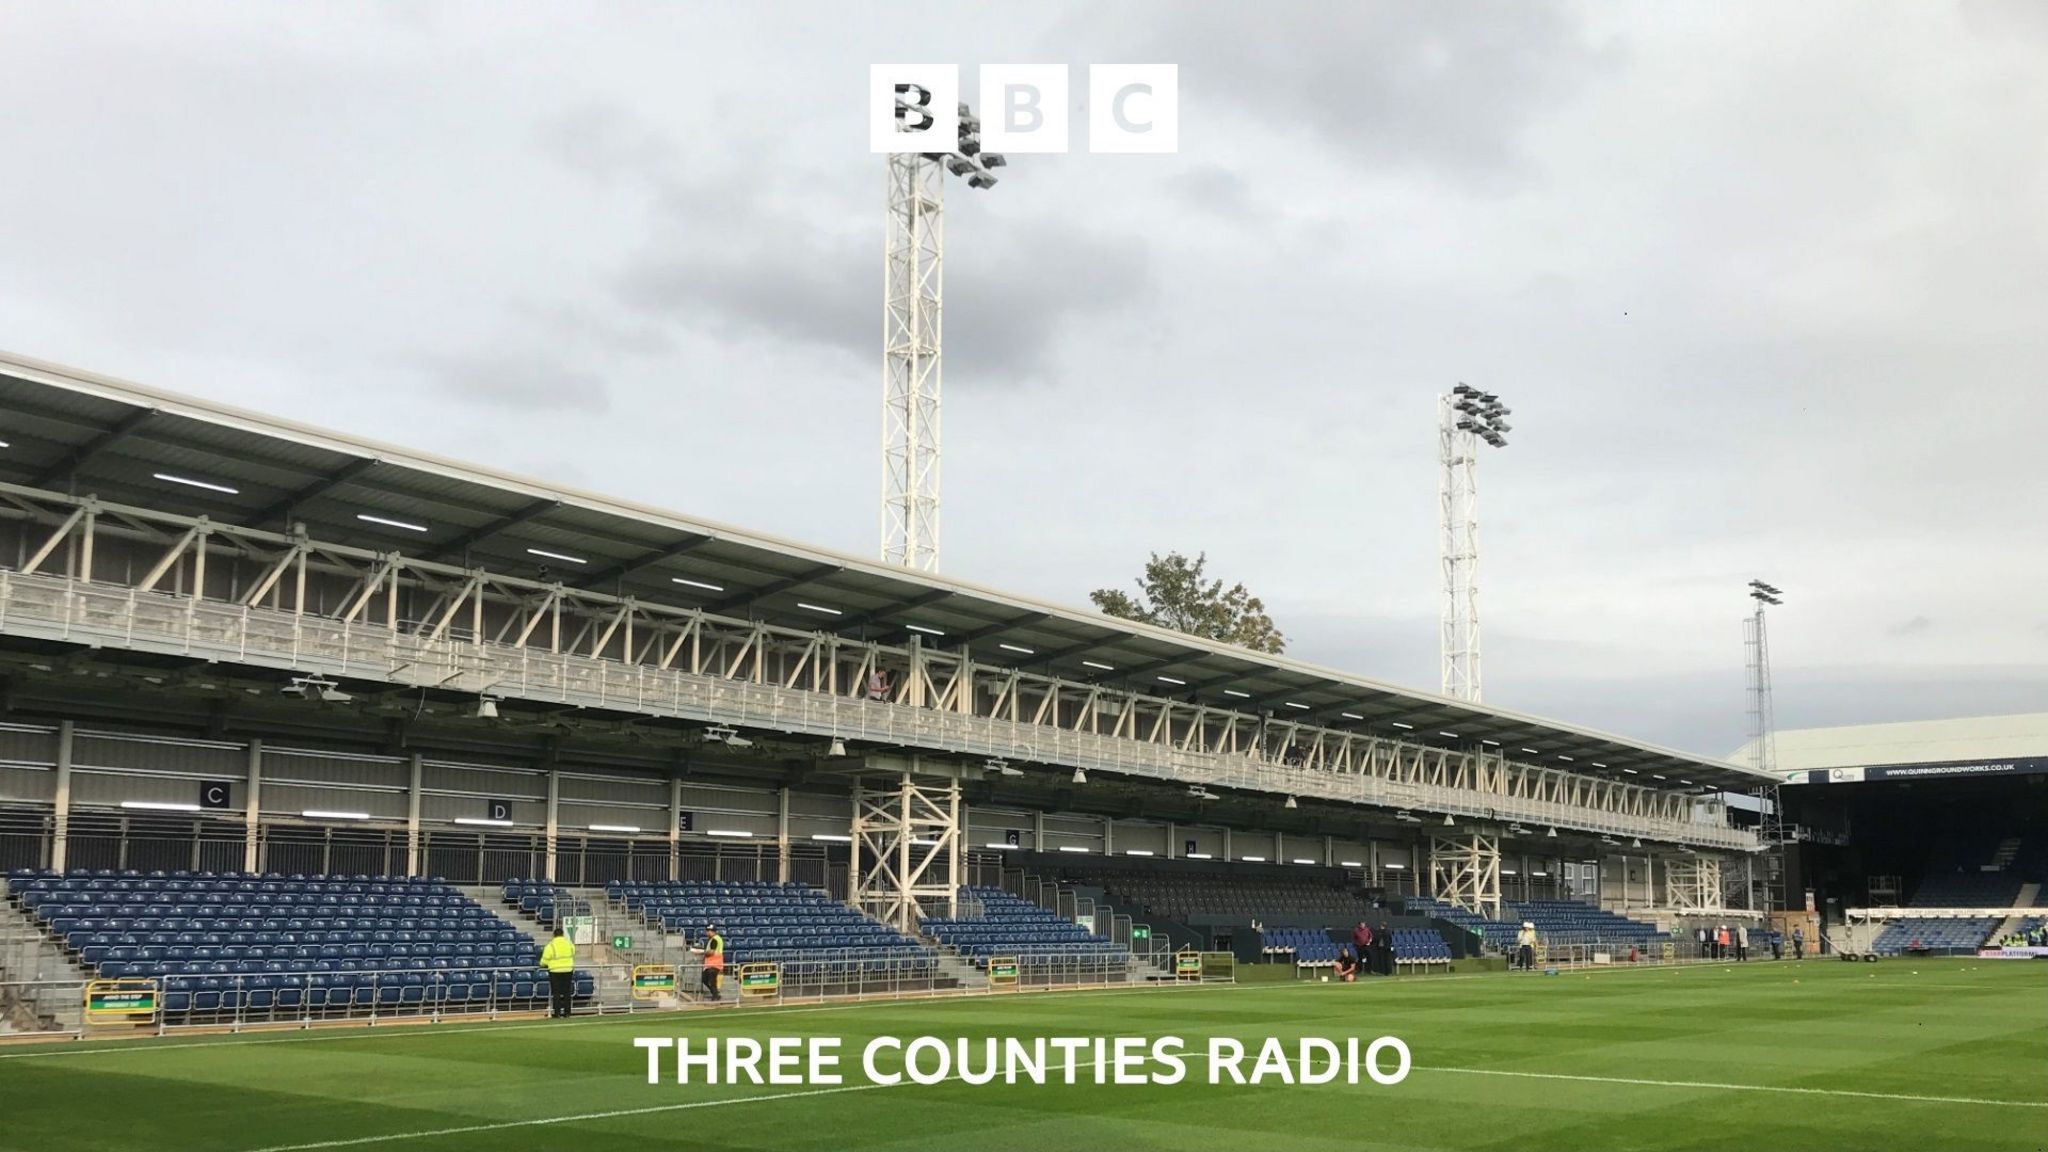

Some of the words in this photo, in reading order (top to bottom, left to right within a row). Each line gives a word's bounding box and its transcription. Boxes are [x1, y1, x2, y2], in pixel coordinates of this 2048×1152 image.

[1886, 763, 2015, 777] WWW.QUINNGROUNDWORKS.CO.UK
[207, 787, 223, 803] C
[495, 805, 506, 819] D
[680, 816, 687, 829] E
[1009, 834, 1017, 846] G
